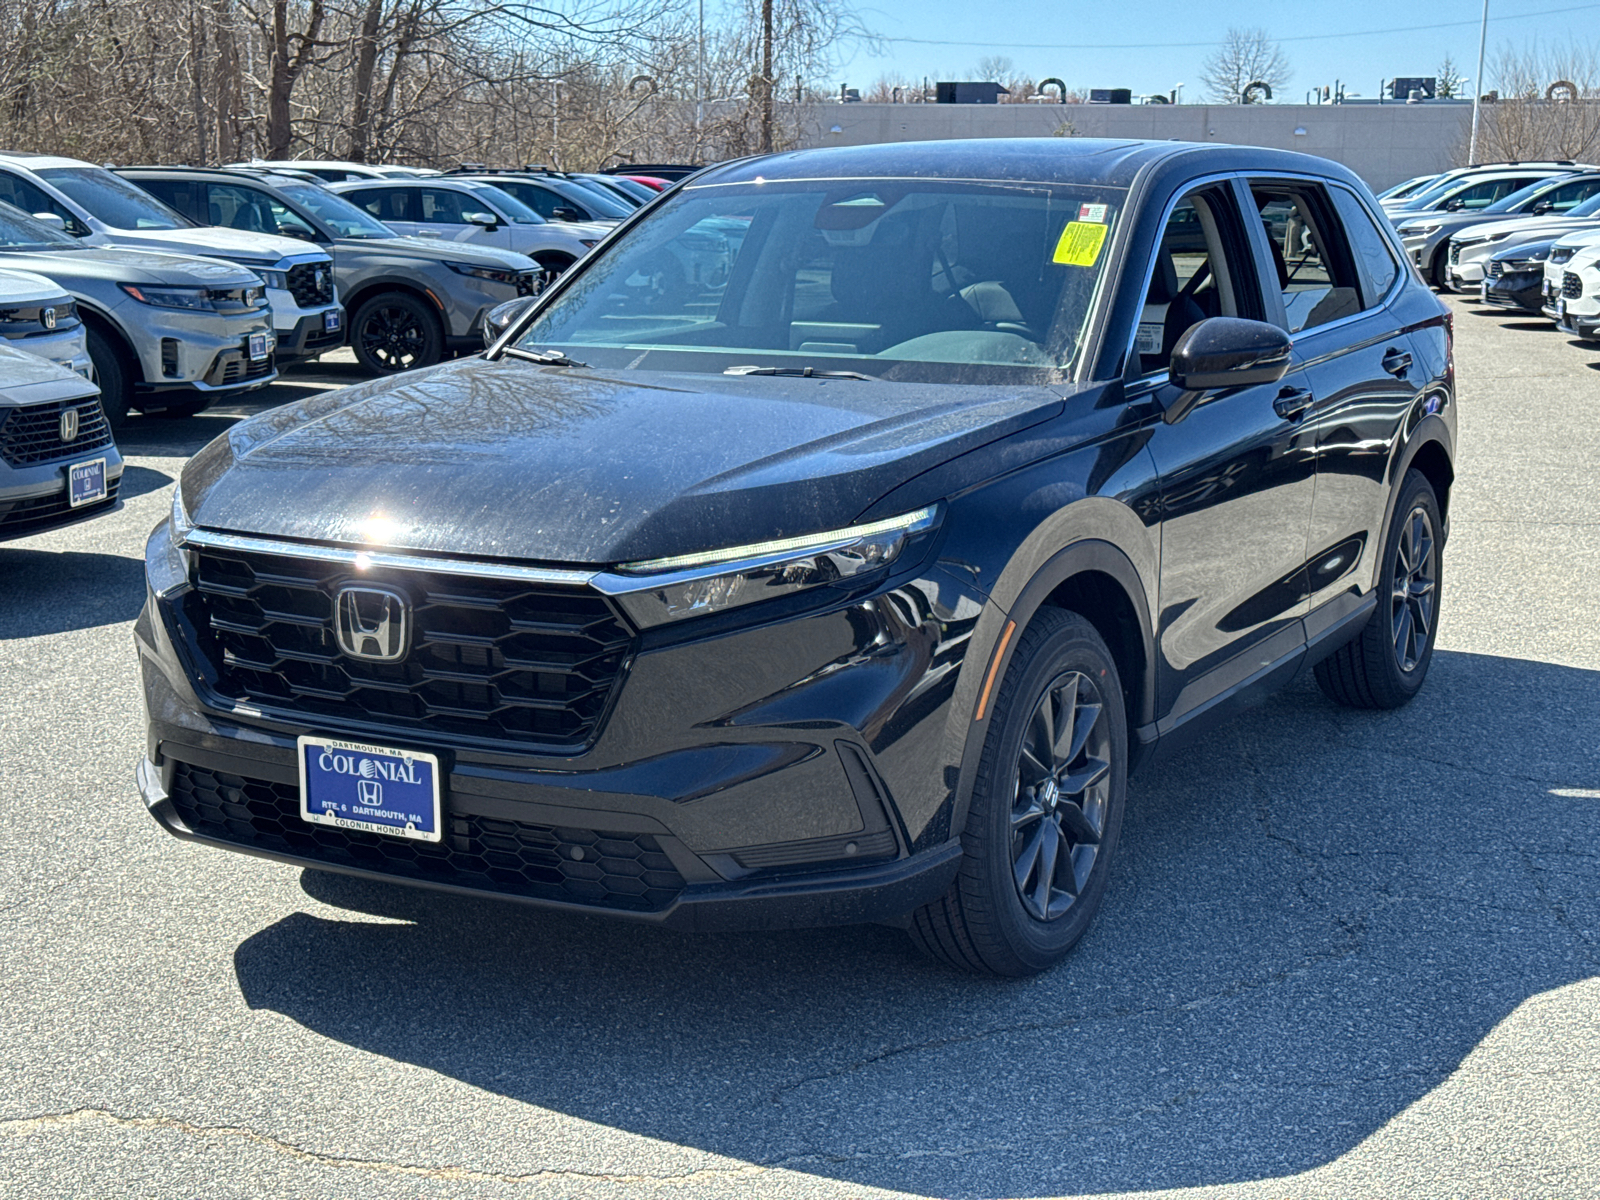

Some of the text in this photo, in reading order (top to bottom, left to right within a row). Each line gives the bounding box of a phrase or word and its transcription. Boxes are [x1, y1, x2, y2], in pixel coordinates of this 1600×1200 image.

[389, 749, 403, 757] MA
[319, 753, 422, 785] COLONIAL
[341, 803, 347, 812] 6
[352, 805, 407, 822] DARTMOUTH,
[408, 813, 423, 824] MA
[334, 818, 406, 836] COLONIAL HONDA
